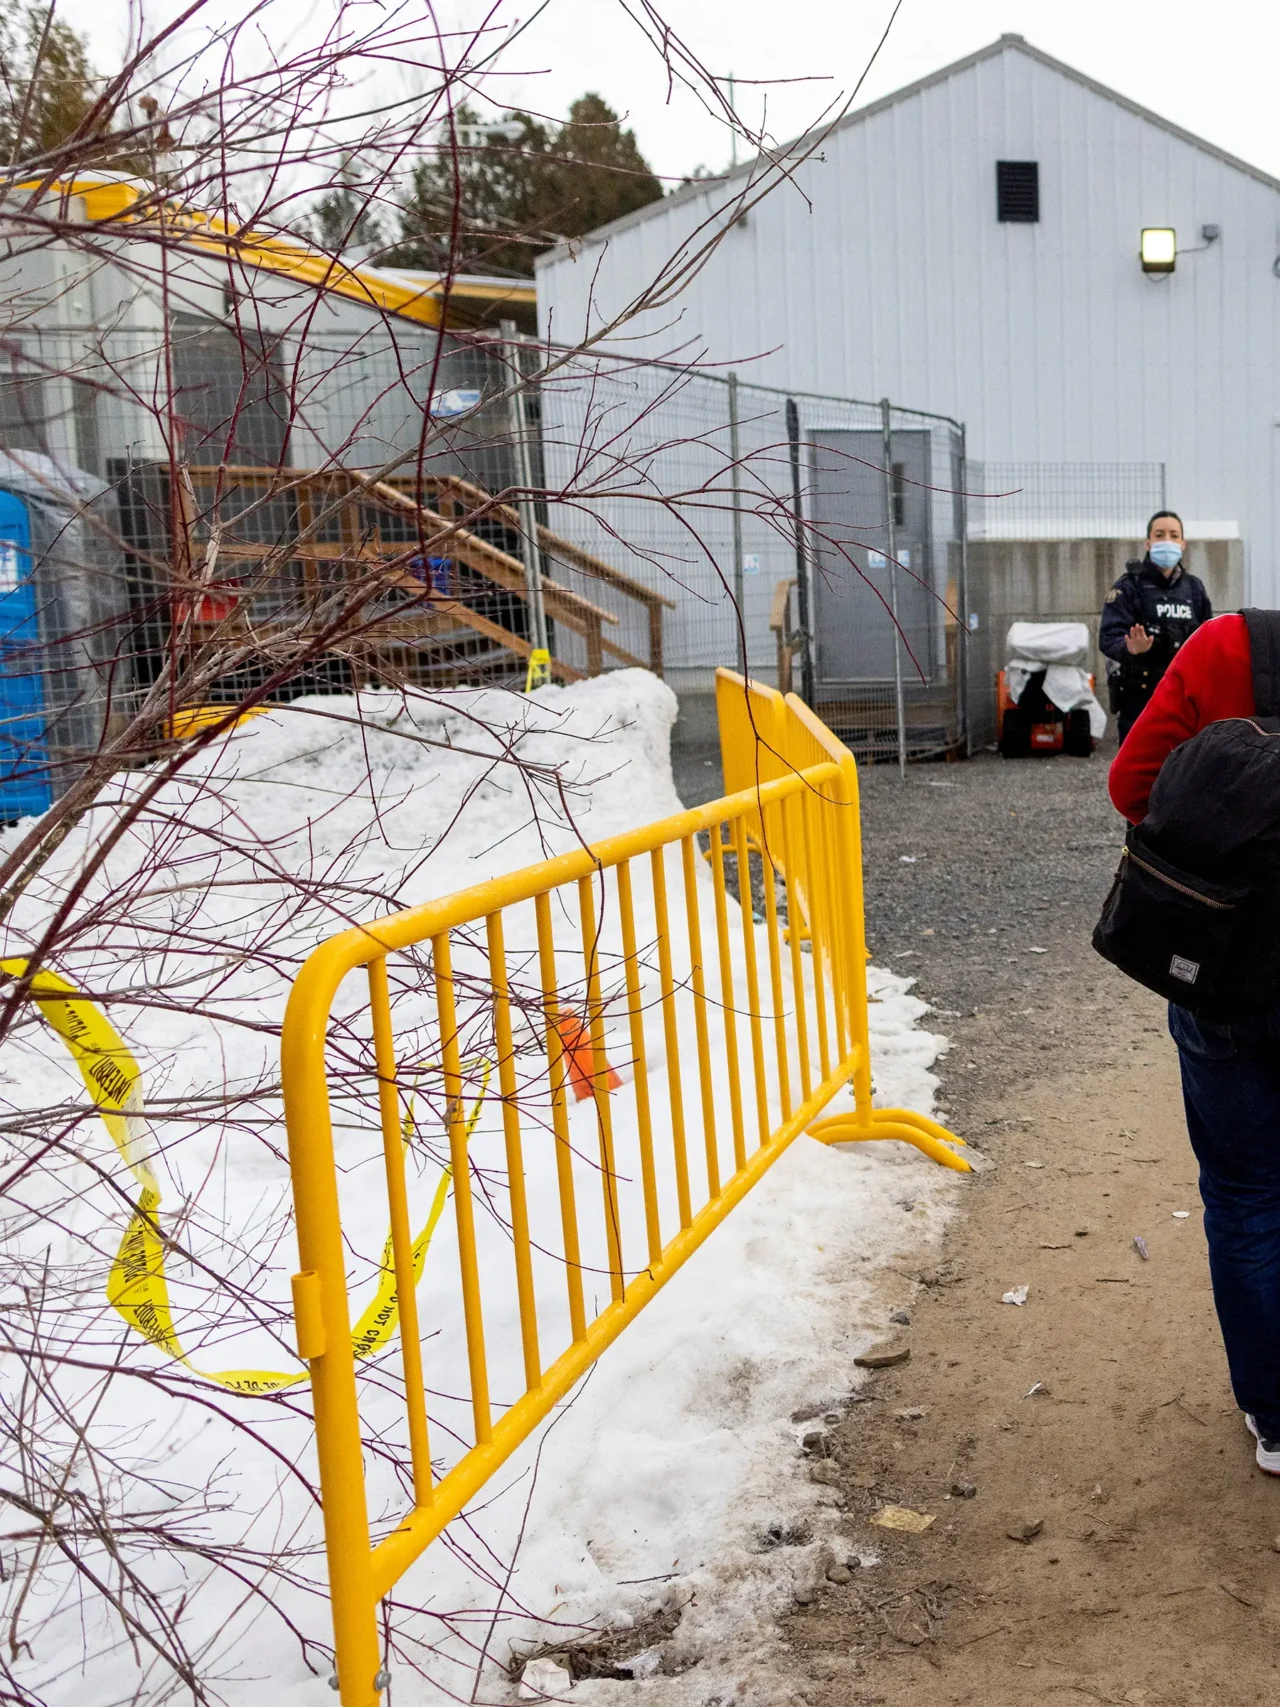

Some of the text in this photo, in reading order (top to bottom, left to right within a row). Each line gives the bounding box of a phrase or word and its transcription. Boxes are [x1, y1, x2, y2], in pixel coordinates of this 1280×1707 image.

[1156, 604, 1192, 619] POLICE
[88, 1055, 131, 1105] INTERDIT
[374, 1305, 395, 1326] NOT
